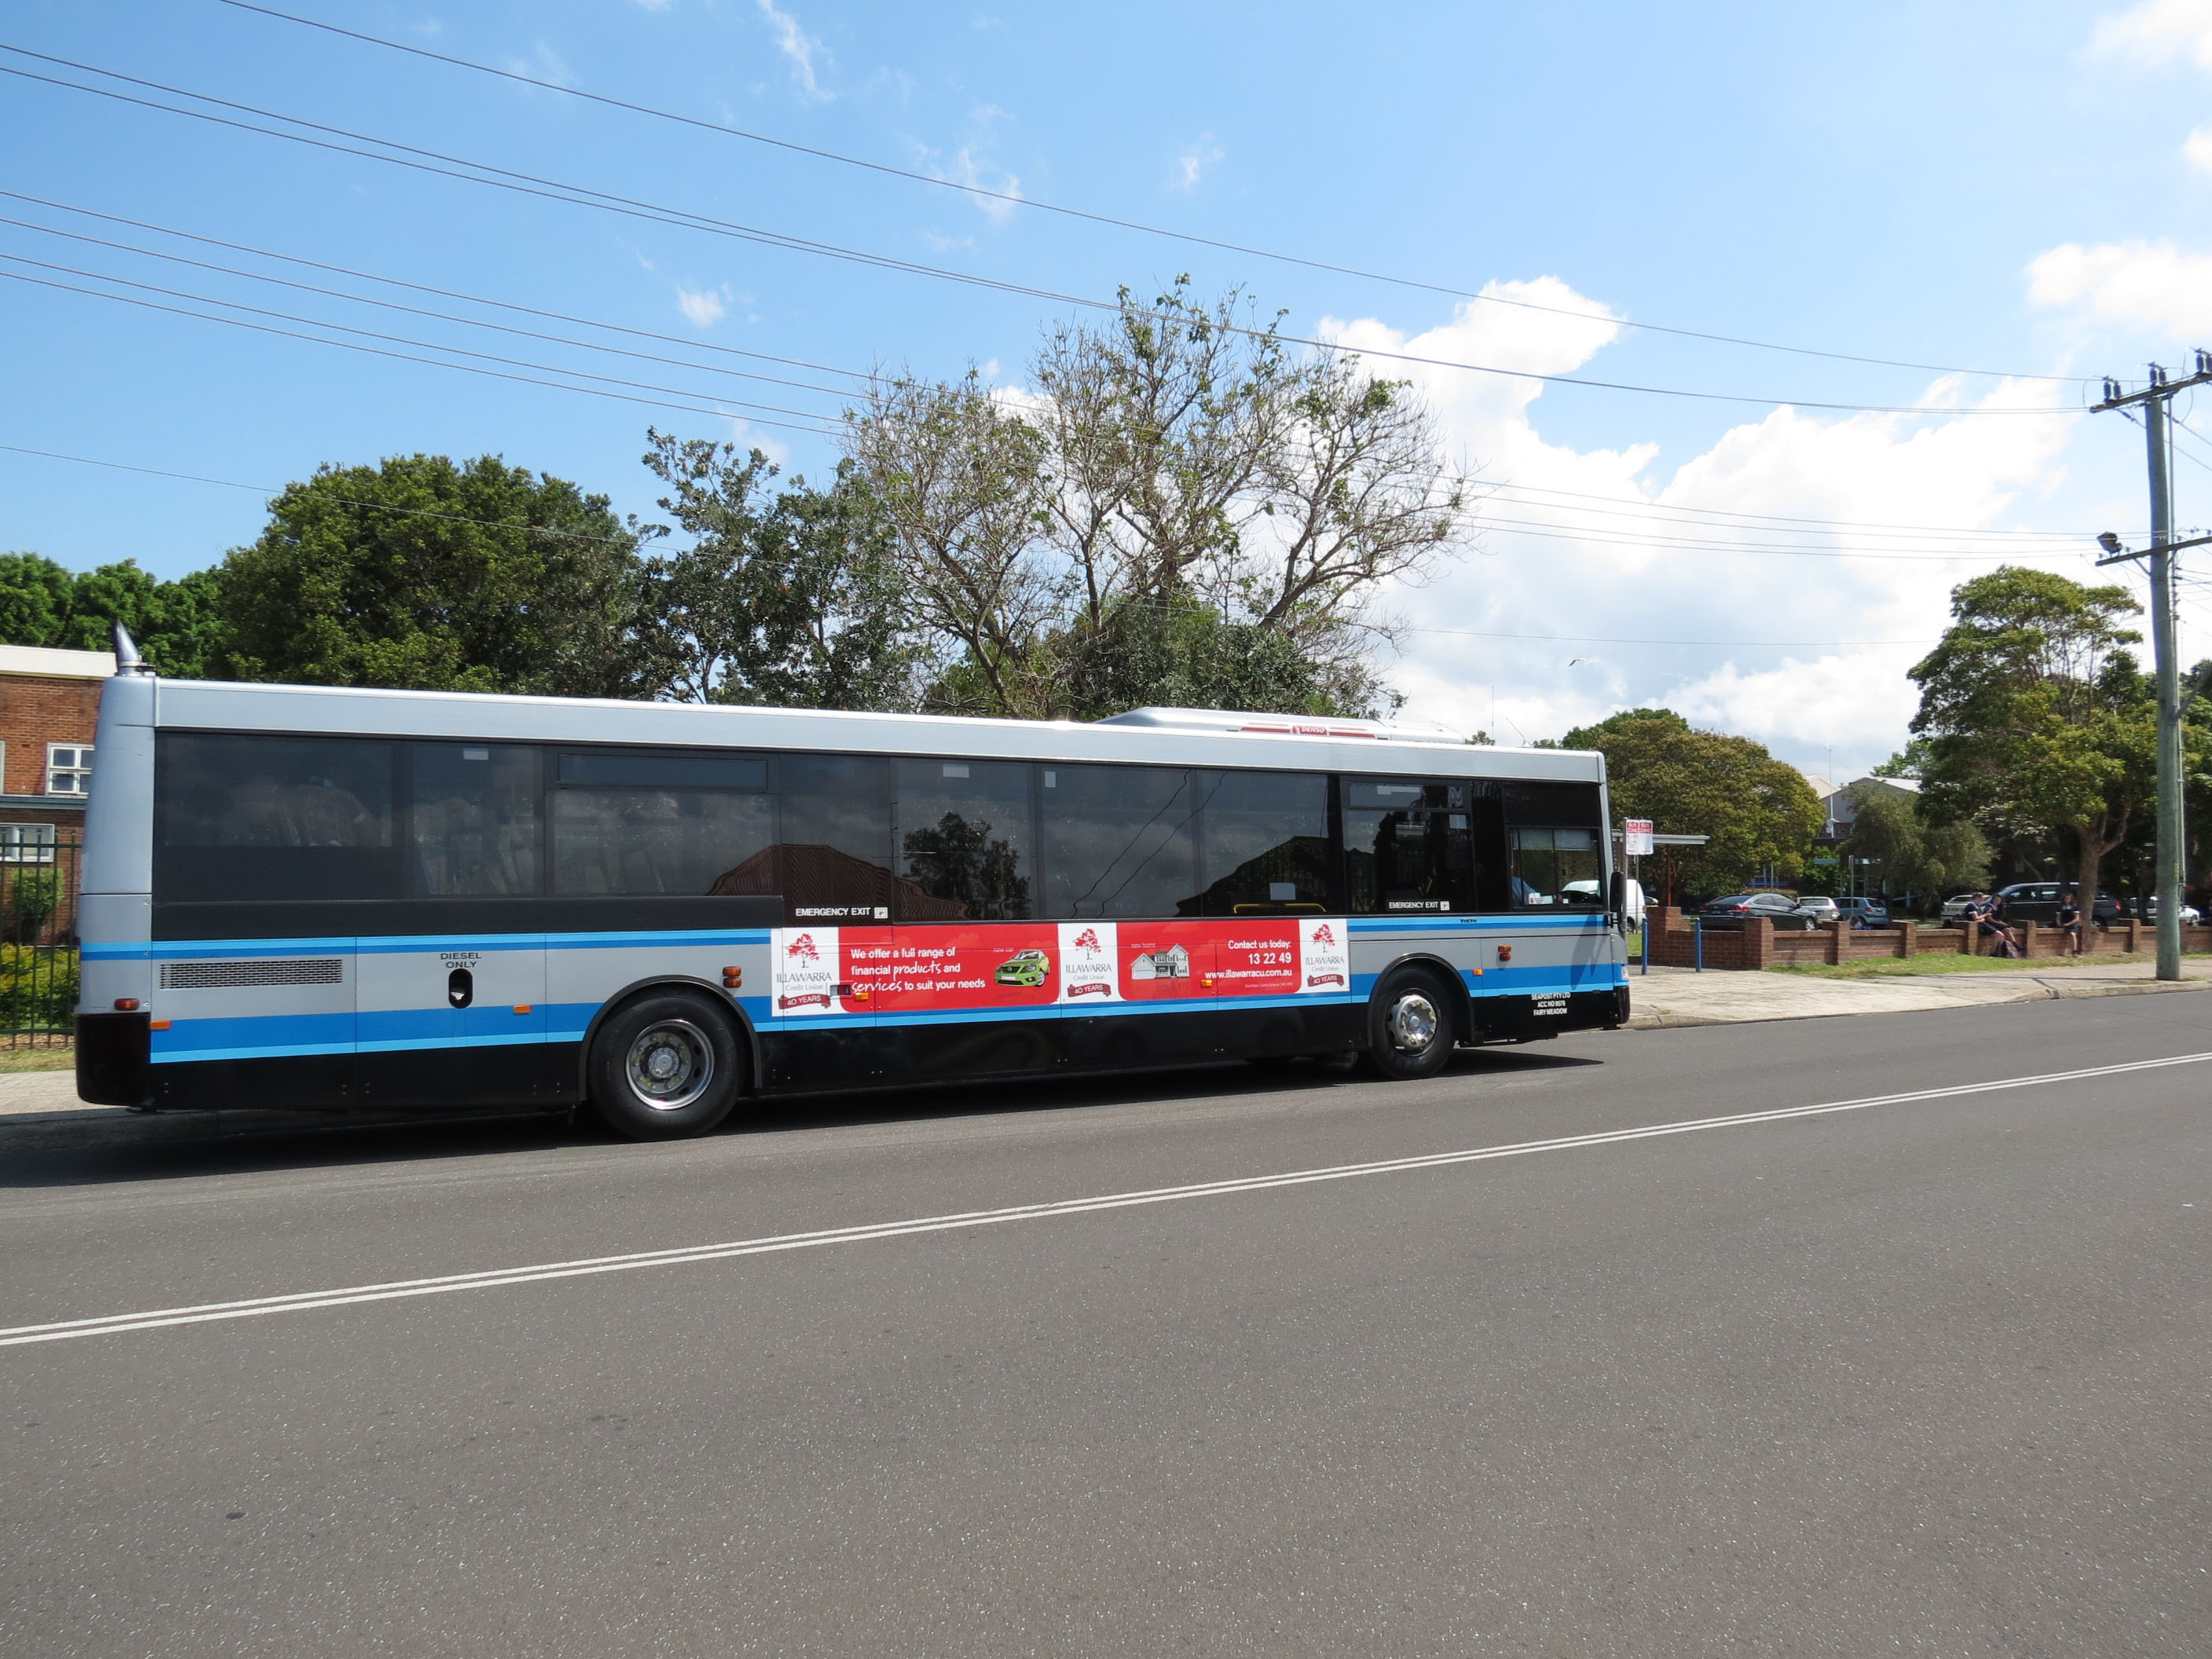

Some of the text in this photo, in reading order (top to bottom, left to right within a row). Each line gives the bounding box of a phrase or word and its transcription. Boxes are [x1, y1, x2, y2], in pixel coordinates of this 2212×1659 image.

[796, 908, 848, 917] EMERGENCY
[1228, 940, 1257, 949] Contact
[1269, 939, 1291, 950] today:
[851, 949, 866, 959] We
[868, 948, 891, 958] offer
[901, 947, 916, 958] full
[917, 949, 944, 959] range
[946, 947, 956, 956] of
[1248, 952, 1292, 965] 13 22 49
[1306, 956, 1345, 965] ILLAWARRA
[851, 960, 961, 982] financial products and
[1066, 964, 1112, 973] ILLAWARRA
[1205, 969, 1292, 979] www.illawarracu.com.au
[776, 972, 833, 983] ILLAWARRA
[851, 978, 986, 993] services to suit your needs
[798, 994, 822, 1005] YEARS
